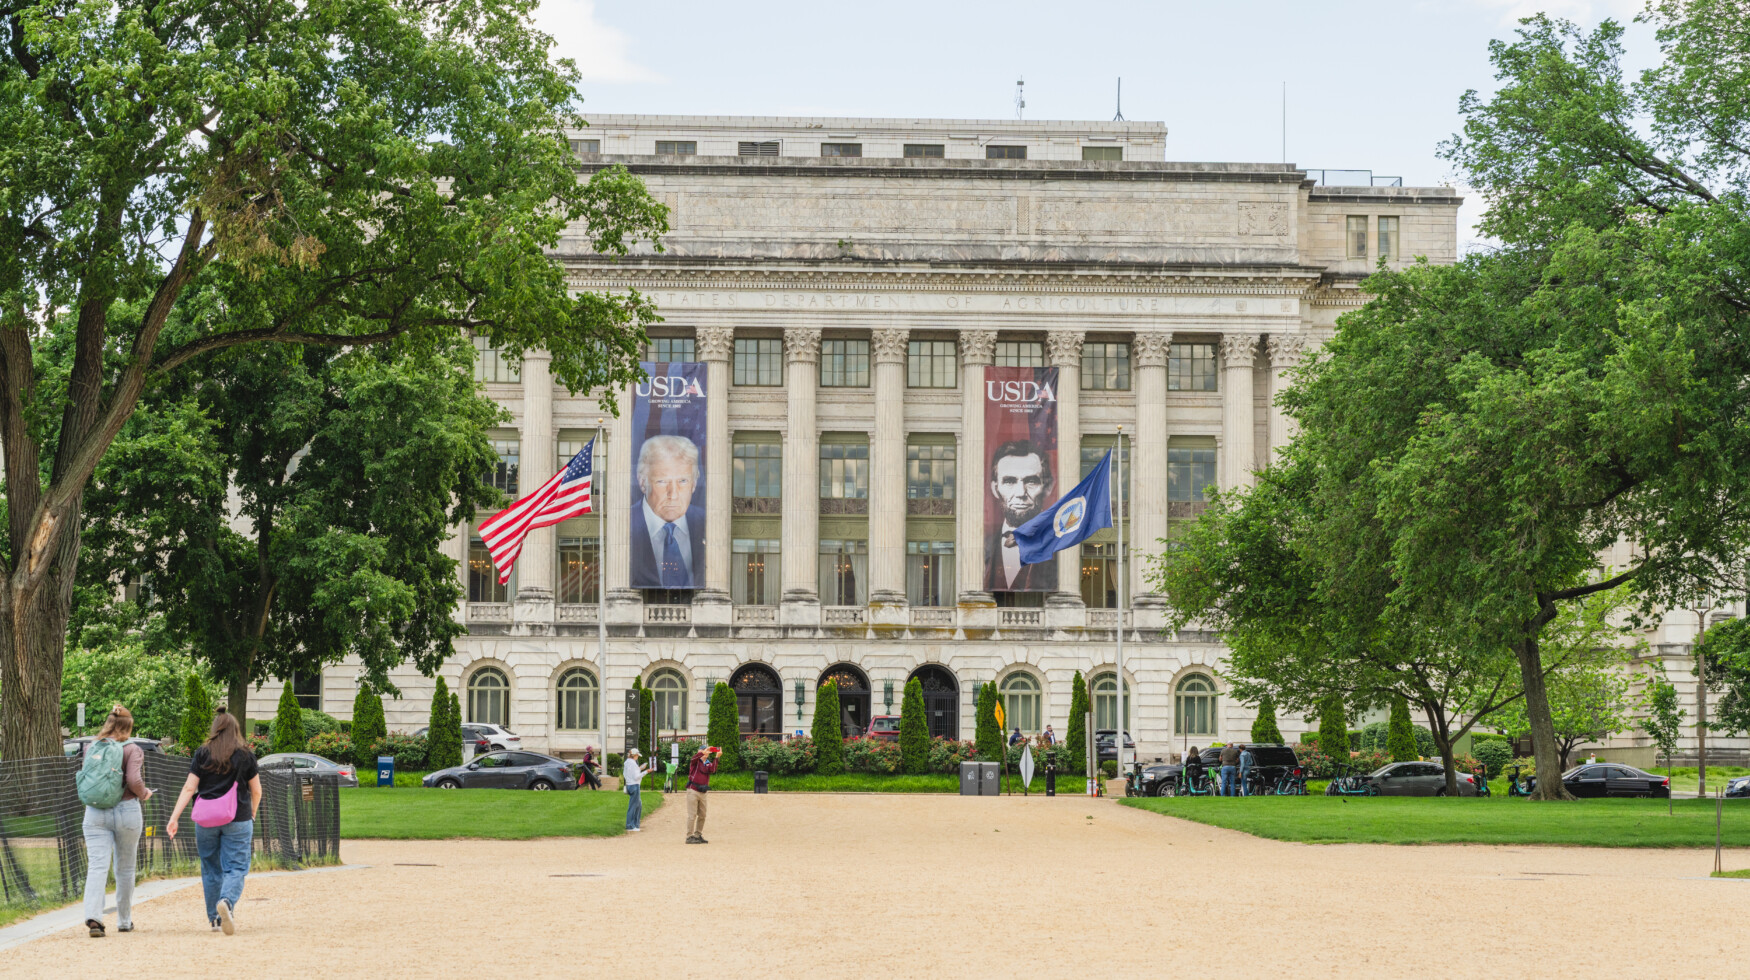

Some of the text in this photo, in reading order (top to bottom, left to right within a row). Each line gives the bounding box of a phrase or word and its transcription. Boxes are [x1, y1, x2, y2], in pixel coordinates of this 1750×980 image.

[653, 293, 1158, 311] STATES DEPARTMENT OF AGRICULTURE
[635, 376, 707, 397] USDA
[985, 380, 1057, 402] USDA
